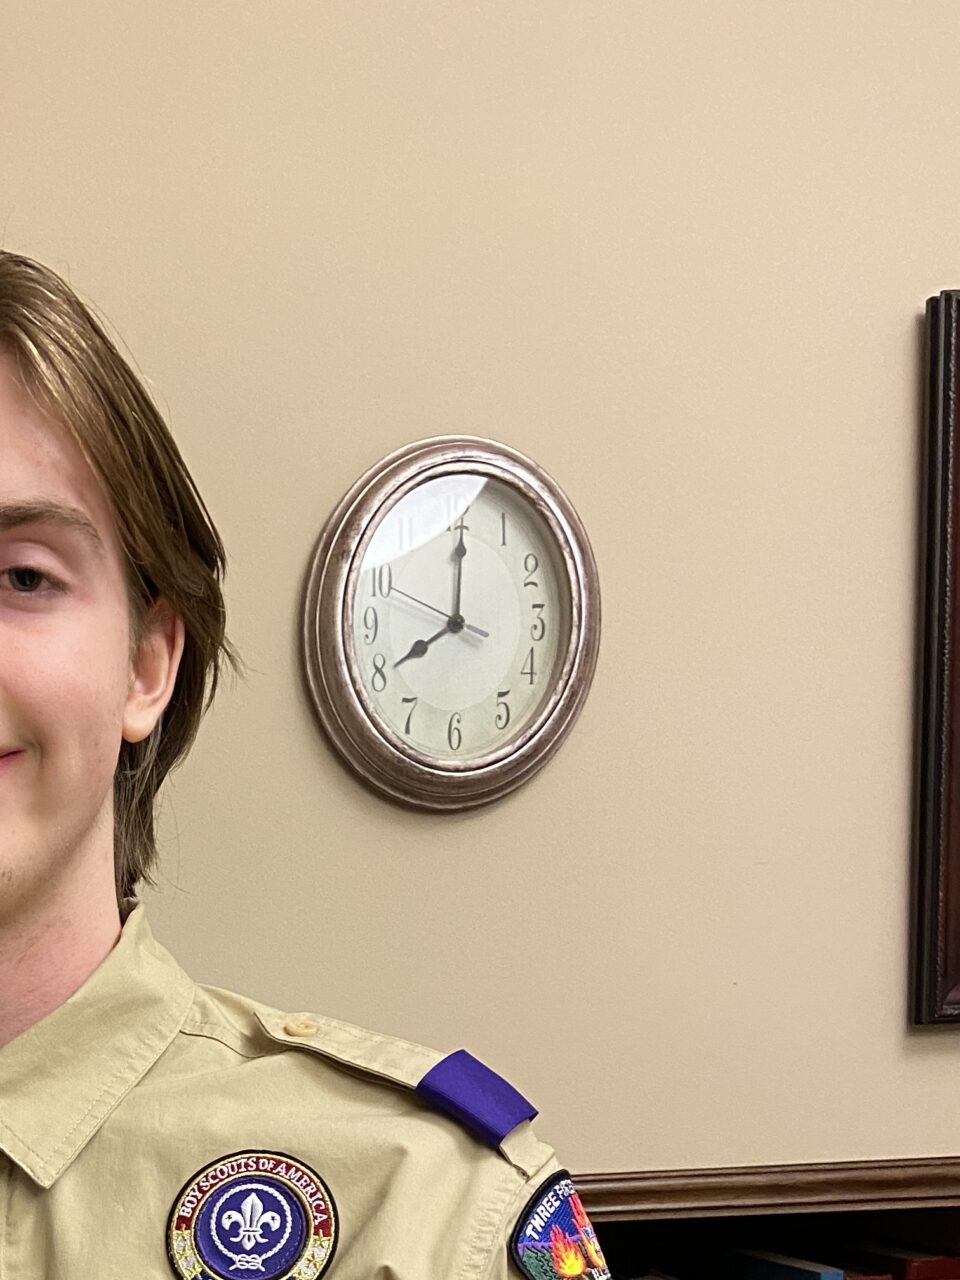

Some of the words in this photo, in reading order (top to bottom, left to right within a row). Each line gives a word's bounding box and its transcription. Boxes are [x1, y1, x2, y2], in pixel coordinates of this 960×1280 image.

[370, 562, 391, 598] 10
[523, 553, 538, 588] 2
[363, 606, 378, 645] 9
[530, 603, 545, 641] 3
[371, 653, 387, 692] 8
[520, 647, 537, 685] 4
[401, 697, 418, 735] 7
[495, 690, 511, 729] 5
[447, 712, 462, 750] 6
[180, 1187, 204, 1218] BOY
[200, 1157, 257, 1191] SCOUTS
[259, 1158, 277, 1172] OF
[276, 1163, 328, 1225] AMERICA
[525, 1191, 561, 1240] THREE
